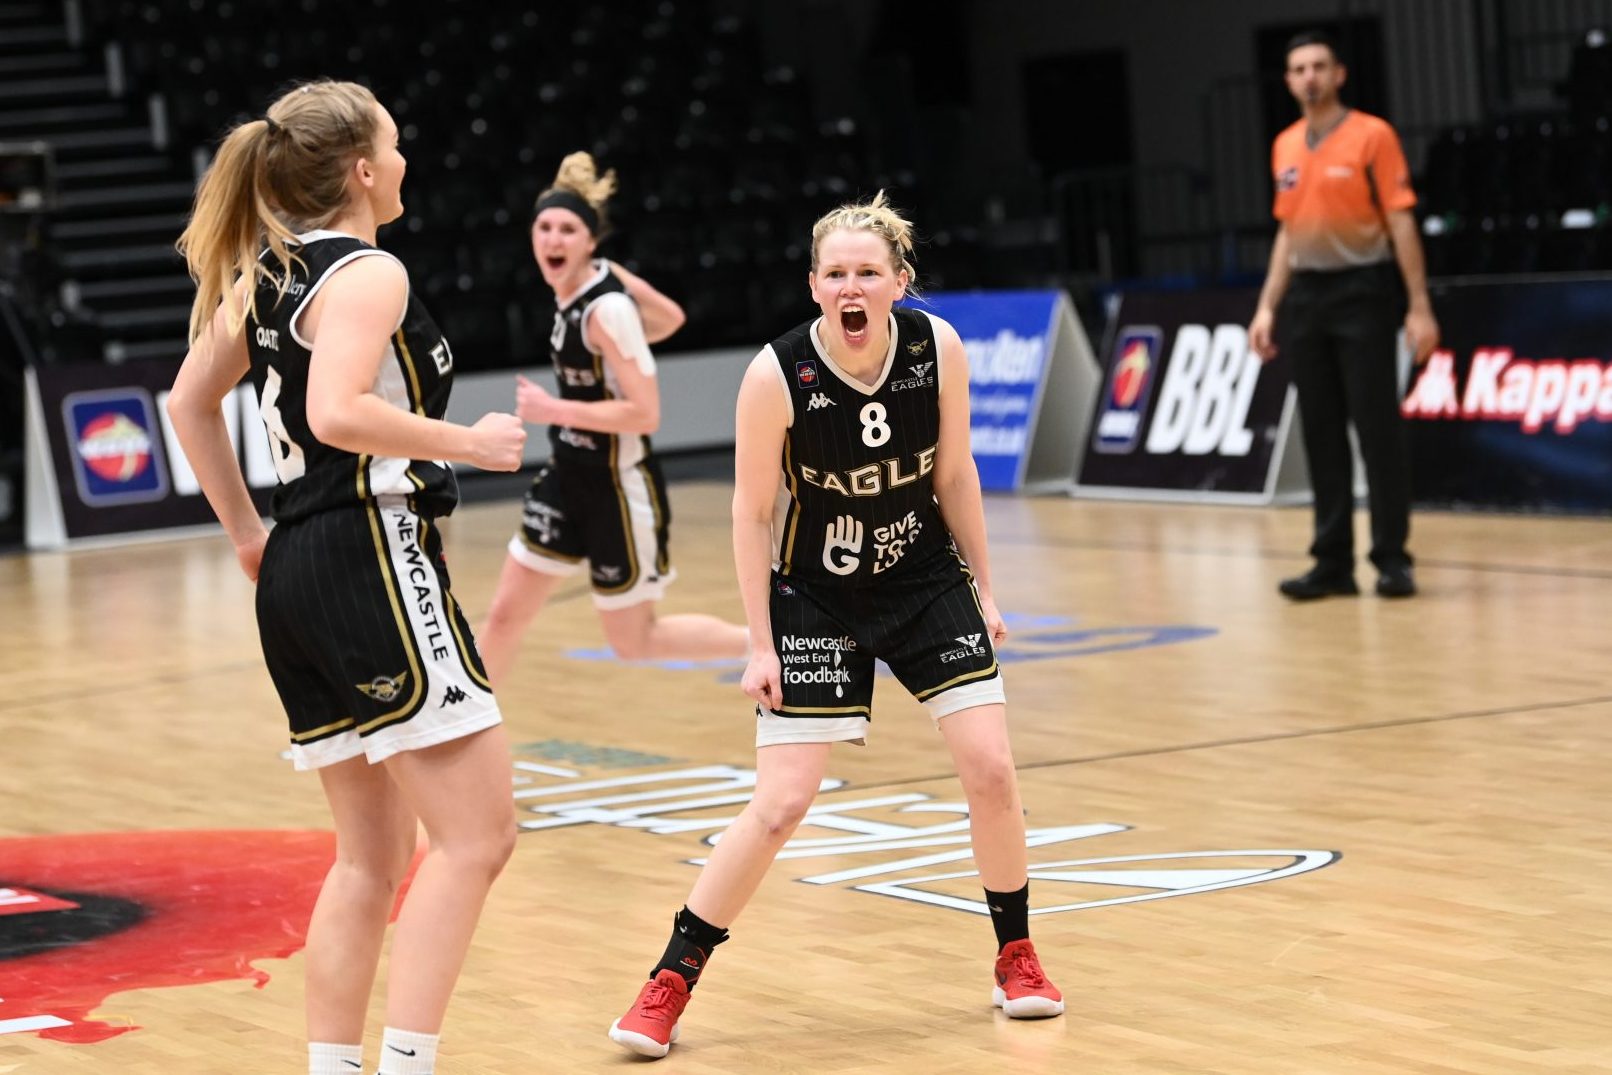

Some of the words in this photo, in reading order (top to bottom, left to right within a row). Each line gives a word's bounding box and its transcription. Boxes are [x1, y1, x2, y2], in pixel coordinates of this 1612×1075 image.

[891, 376, 934, 392] EAGLES
[1145, 323, 1261, 456] BBL
[859, 402, 892, 448] 8
[873, 510, 917, 543] GIVE
[393, 513, 449, 662] NEWCASTLE
[781, 634, 857, 652] Newcastle
[782, 654, 810, 665] West
[812, 653, 831, 664] End
[940, 646, 986, 664] EAGLES
[783, 666, 852, 685] foodbank
